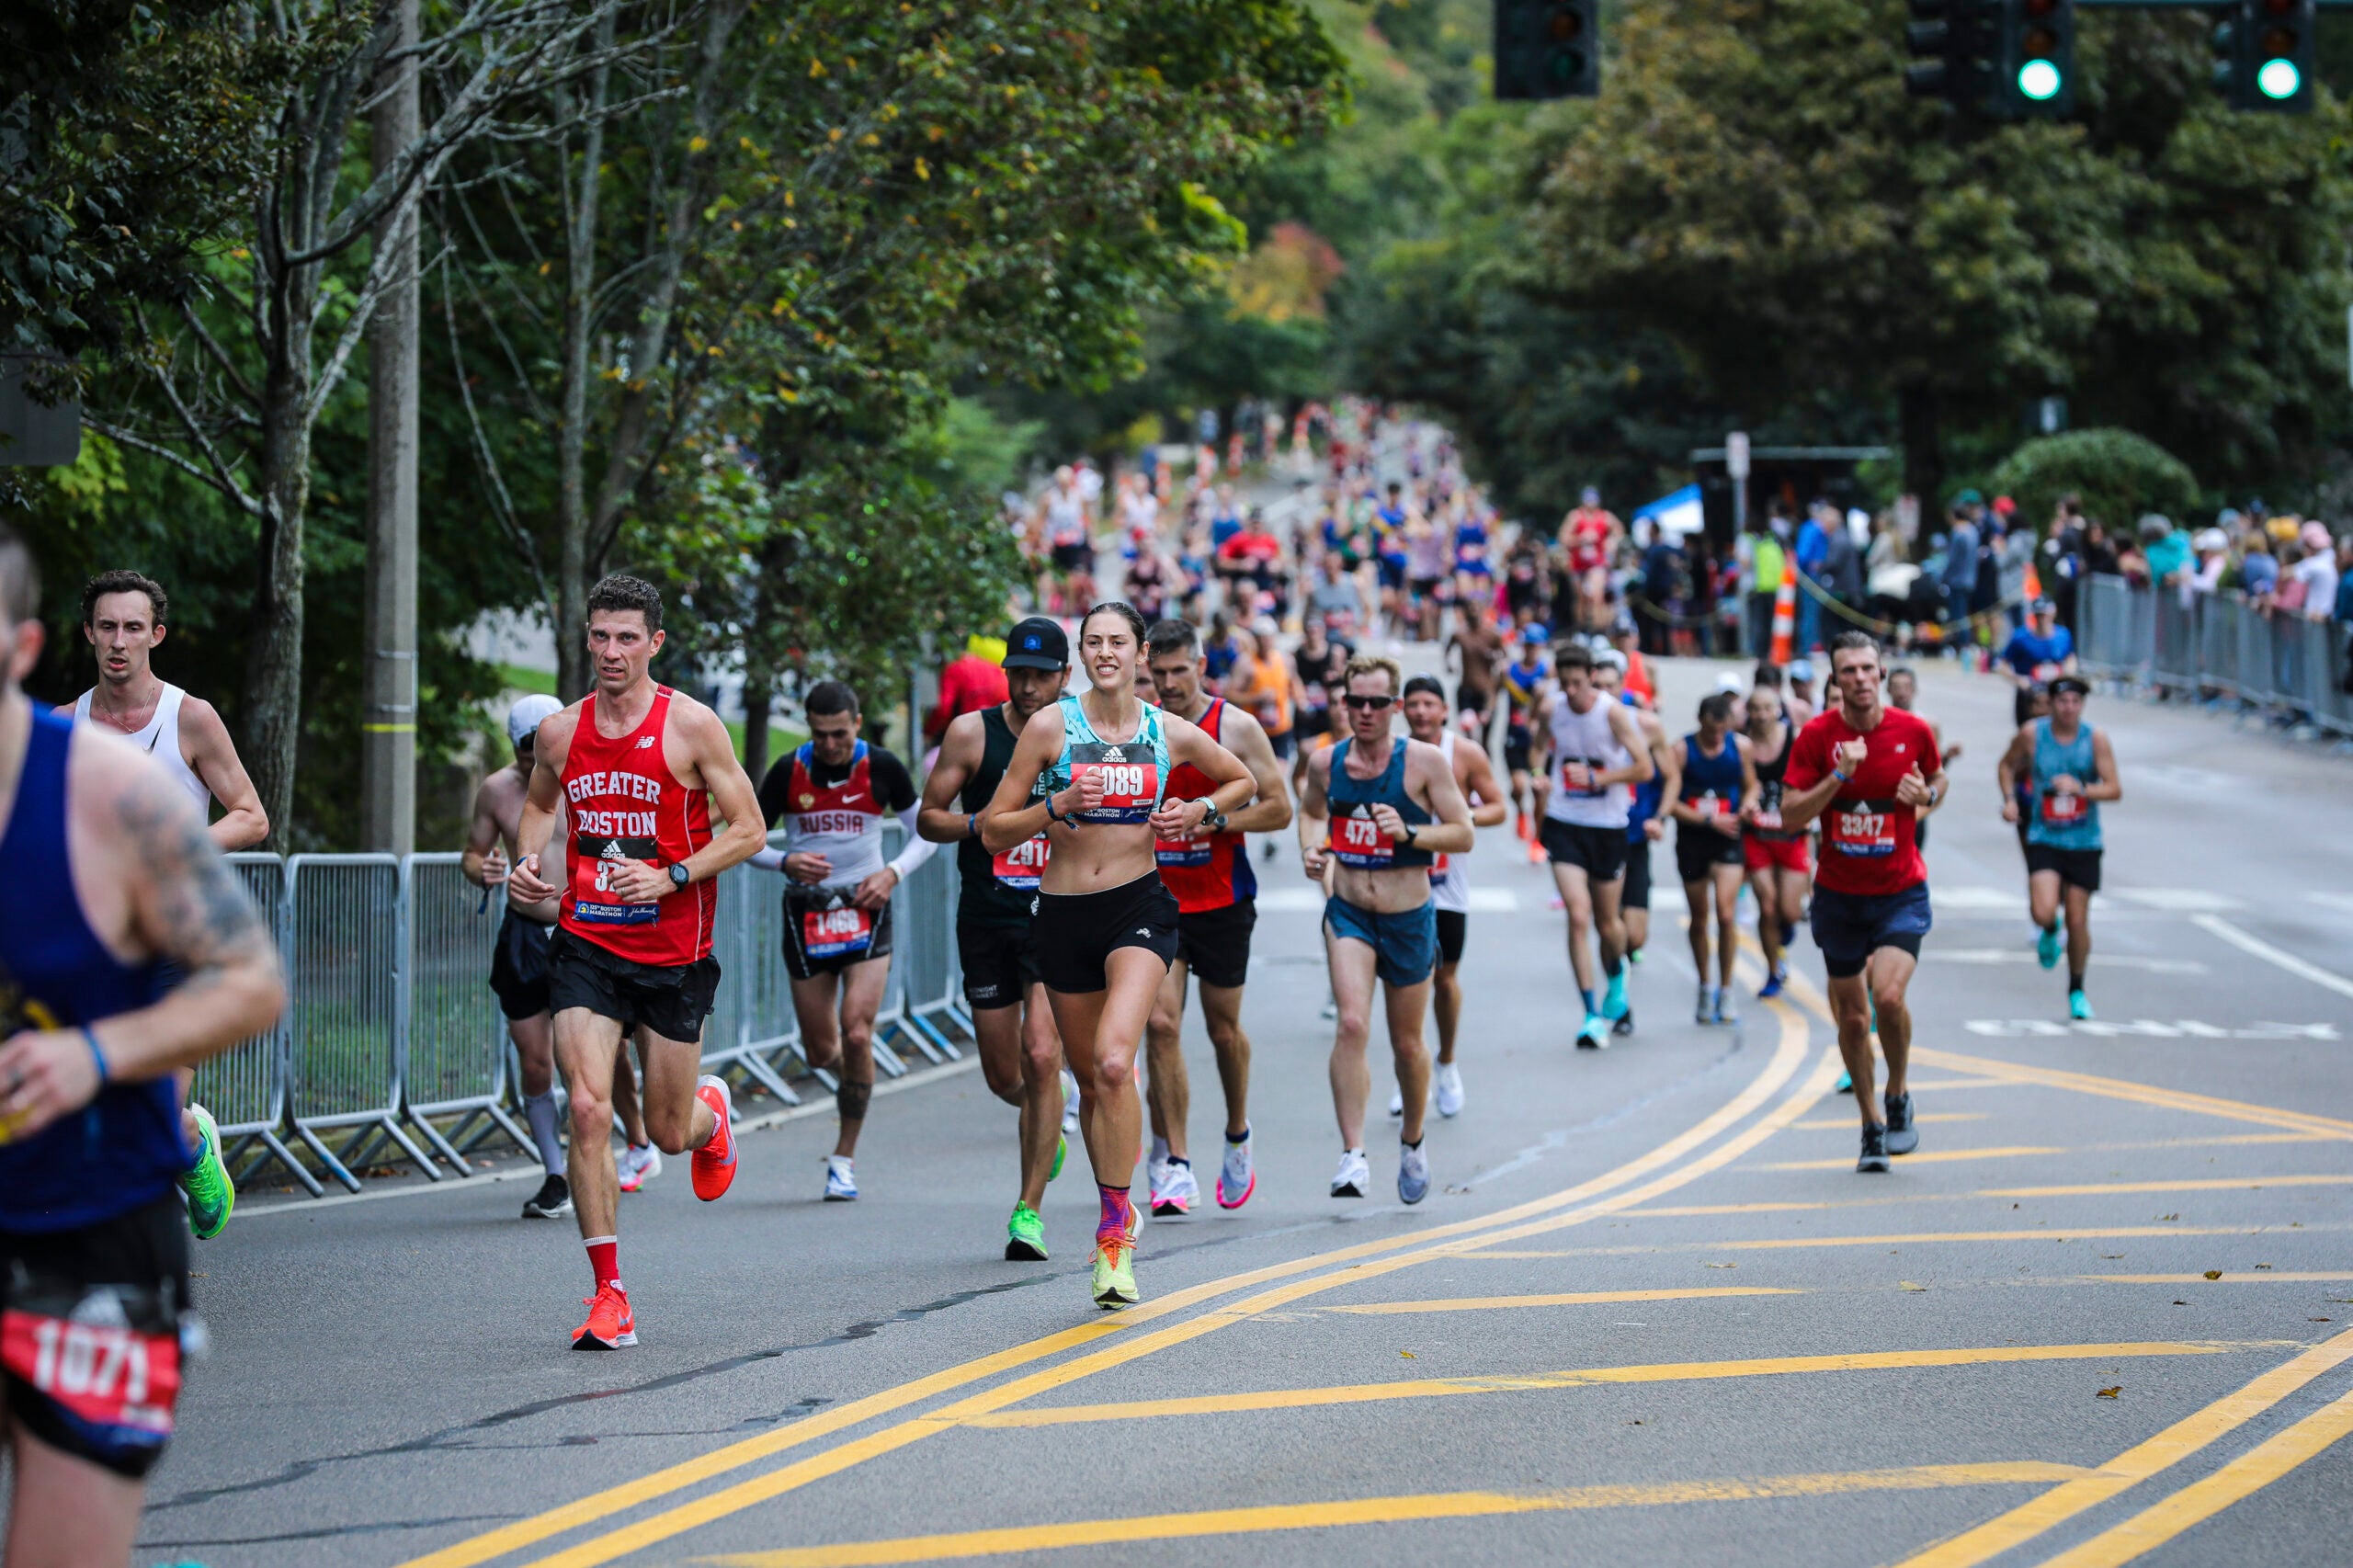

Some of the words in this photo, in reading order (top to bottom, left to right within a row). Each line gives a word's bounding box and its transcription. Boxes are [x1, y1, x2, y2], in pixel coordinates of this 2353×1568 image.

[567, 771, 661, 805] GREATER
[1087, 766, 1143, 796] 089
[576, 810, 656, 836] BOSTON
[798, 813, 863, 835] RUSSIA
[1345, 820, 1377, 846] 473
[1841, 813, 1884, 836] 3347
[33, 1318, 149, 1403] 1071
